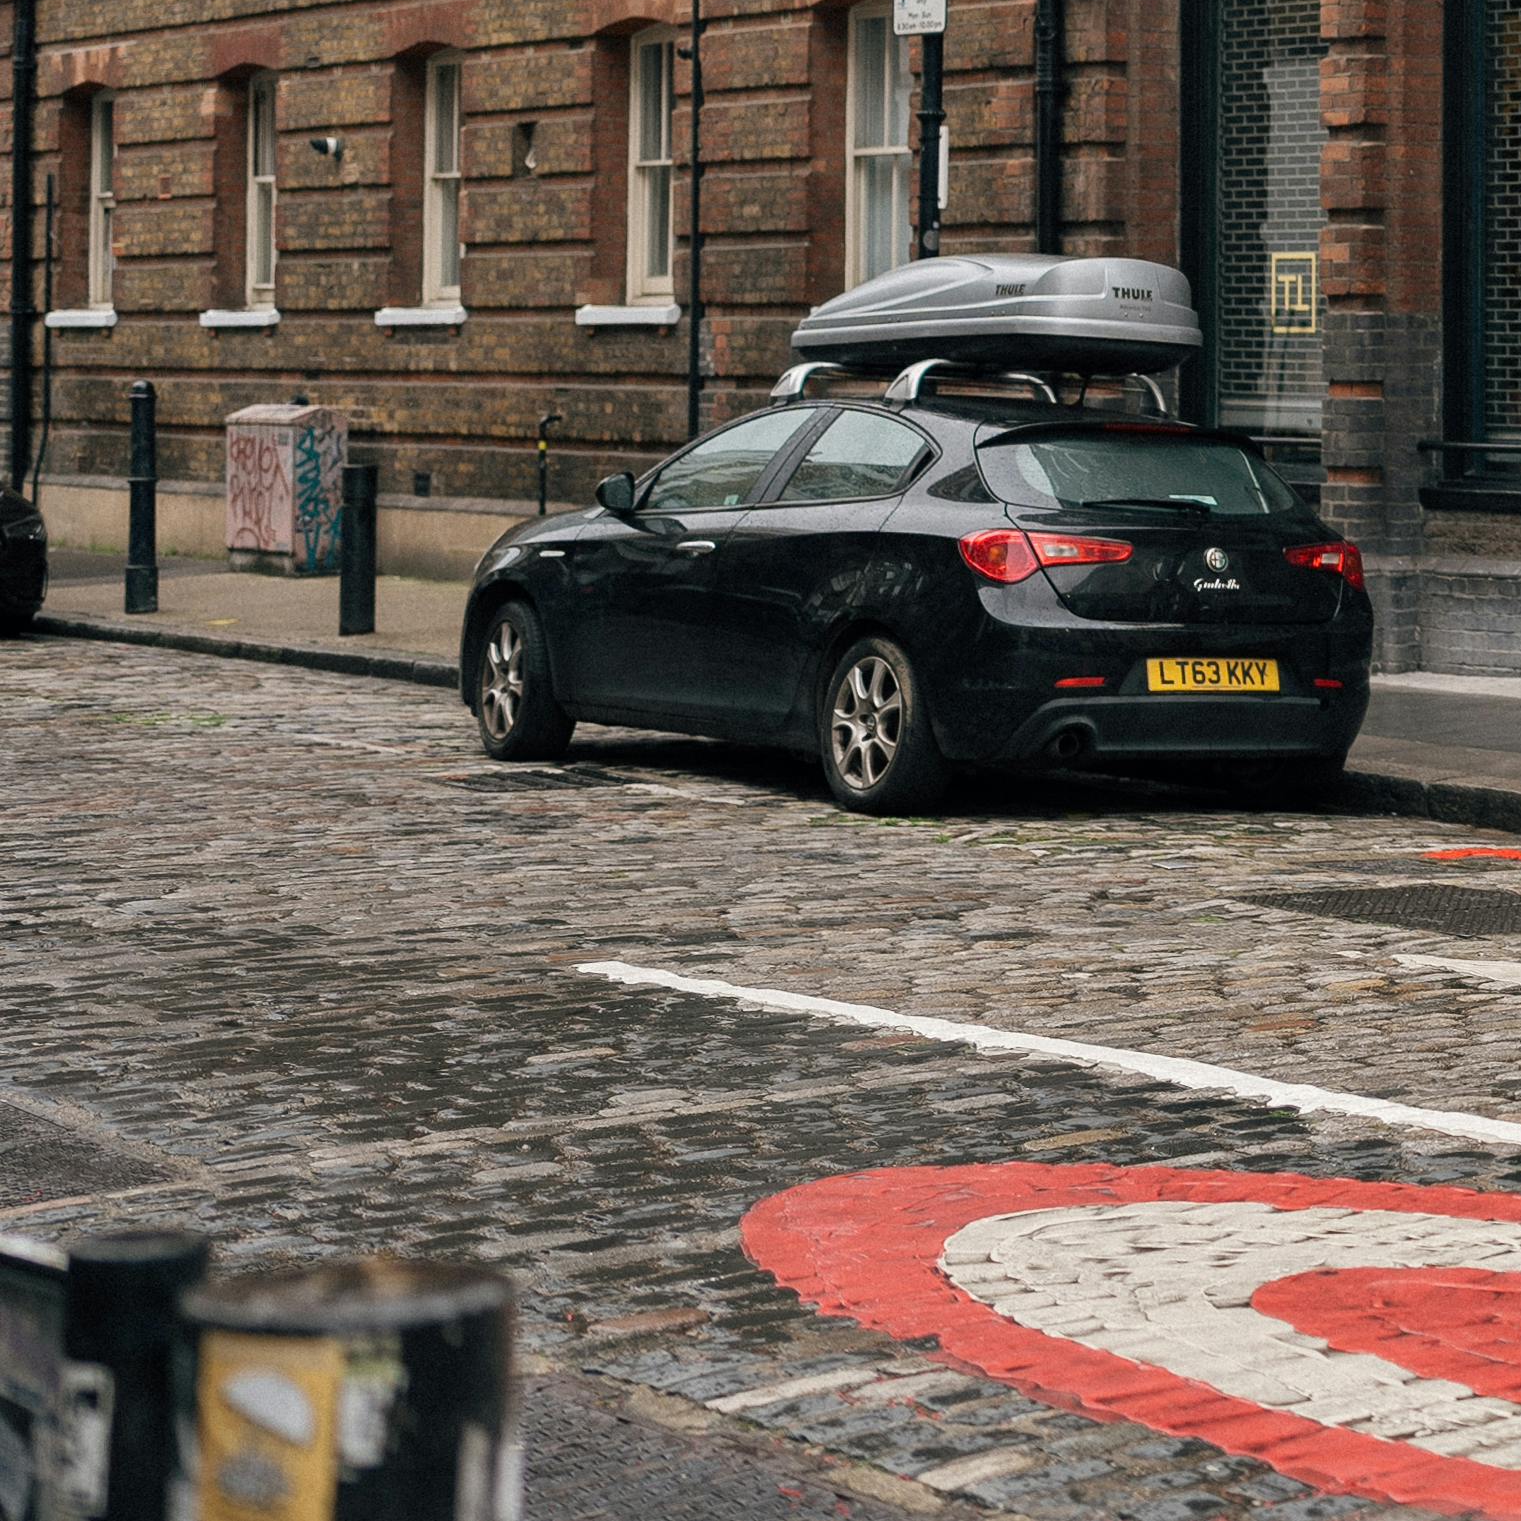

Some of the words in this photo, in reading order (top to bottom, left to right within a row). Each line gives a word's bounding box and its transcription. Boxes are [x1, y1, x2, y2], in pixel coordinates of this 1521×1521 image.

[994, 283, 1026, 296] THULE
[1111, 286, 1153, 302] THULE
[1158, 661, 1221, 685] LT63
[1226, 662, 1267, 686] KKY
